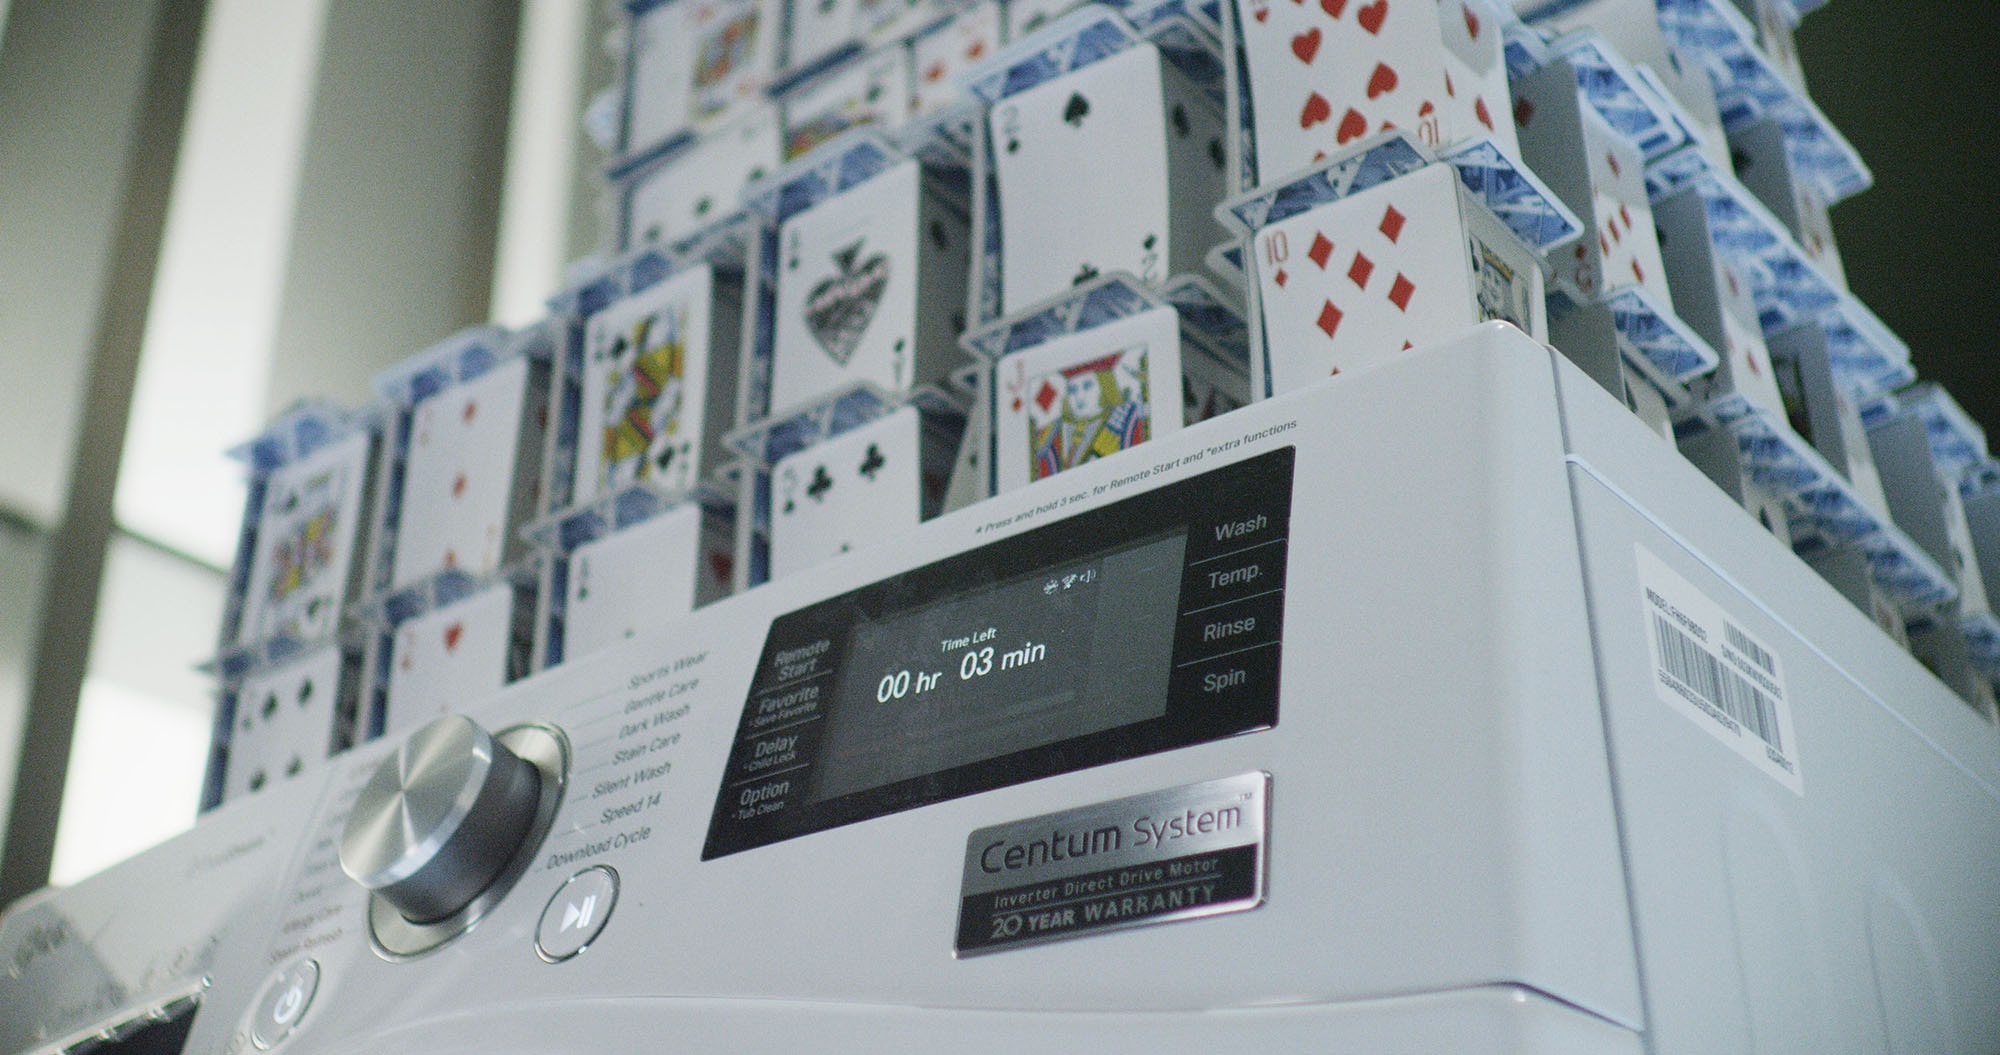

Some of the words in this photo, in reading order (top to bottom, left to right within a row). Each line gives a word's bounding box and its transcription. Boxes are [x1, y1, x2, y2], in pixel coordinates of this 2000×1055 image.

[1265, 230, 1289, 265] 10
[985, 516, 1012, 533] Press
[1015, 507, 1035, 522] and
[1036, 499, 1059, 517] hold
[1060, 498, 1067, 508] 3
[1069, 492, 1088, 505] sec.
[1093, 484, 1109, 498] for
[1110, 469, 1151, 490] Remote
[1153, 457, 1181, 476] Start
[1183, 449, 1204, 466] and
[1243, 420, 1297, 446] functions
[1215, 514, 1267, 541] Wash
[1208, 564, 1264, 589] Temp.
[941, 636, 970, 653] Time
[972, 627, 997, 644] Left
[1203, 616, 1256, 642] Rinse
[774, 639, 831, 668] Remote
[777, 658, 818, 682] Start
[877, 670, 911, 704] 00
[916, 671, 942, 695] hr
[960, 646, 995, 680] 03
[1001, 641, 1046, 671] min
[1203, 668, 1246, 694] Spin
[758, 685, 820, 716] Favorite
[618, 719, 650, 741] Dark
[653, 703, 692, 728] Wash
[611, 743, 648, 766] Stain
[650, 732, 681, 752] Care
[754, 735, 798, 758] Delay
[592, 775, 632, 799] Silent
[634, 761, 671, 785] Wash
[740, 780, 790, 808] Option
[600, 797, 645, 825] Speed
[646, 791, 663, 810] 14
[546, 836, 614, 871] Download
[614, 826, 652, 850] Cycle
[980, 825, 1121, 874] Centum
[1133, 805, 1241, 849] System
[993, 886, 1058, 910] Inverter
[1064, 875, 1115, 897] Direct
[1119, 864, 1164, 886] Drive
[1169, 856, 1220, 877] Motor
[991, 914, 1023, 939] 20
[1027, 907, 1076, 931] YEAR
[1084, 883, 1217, 923] WARRANTY
